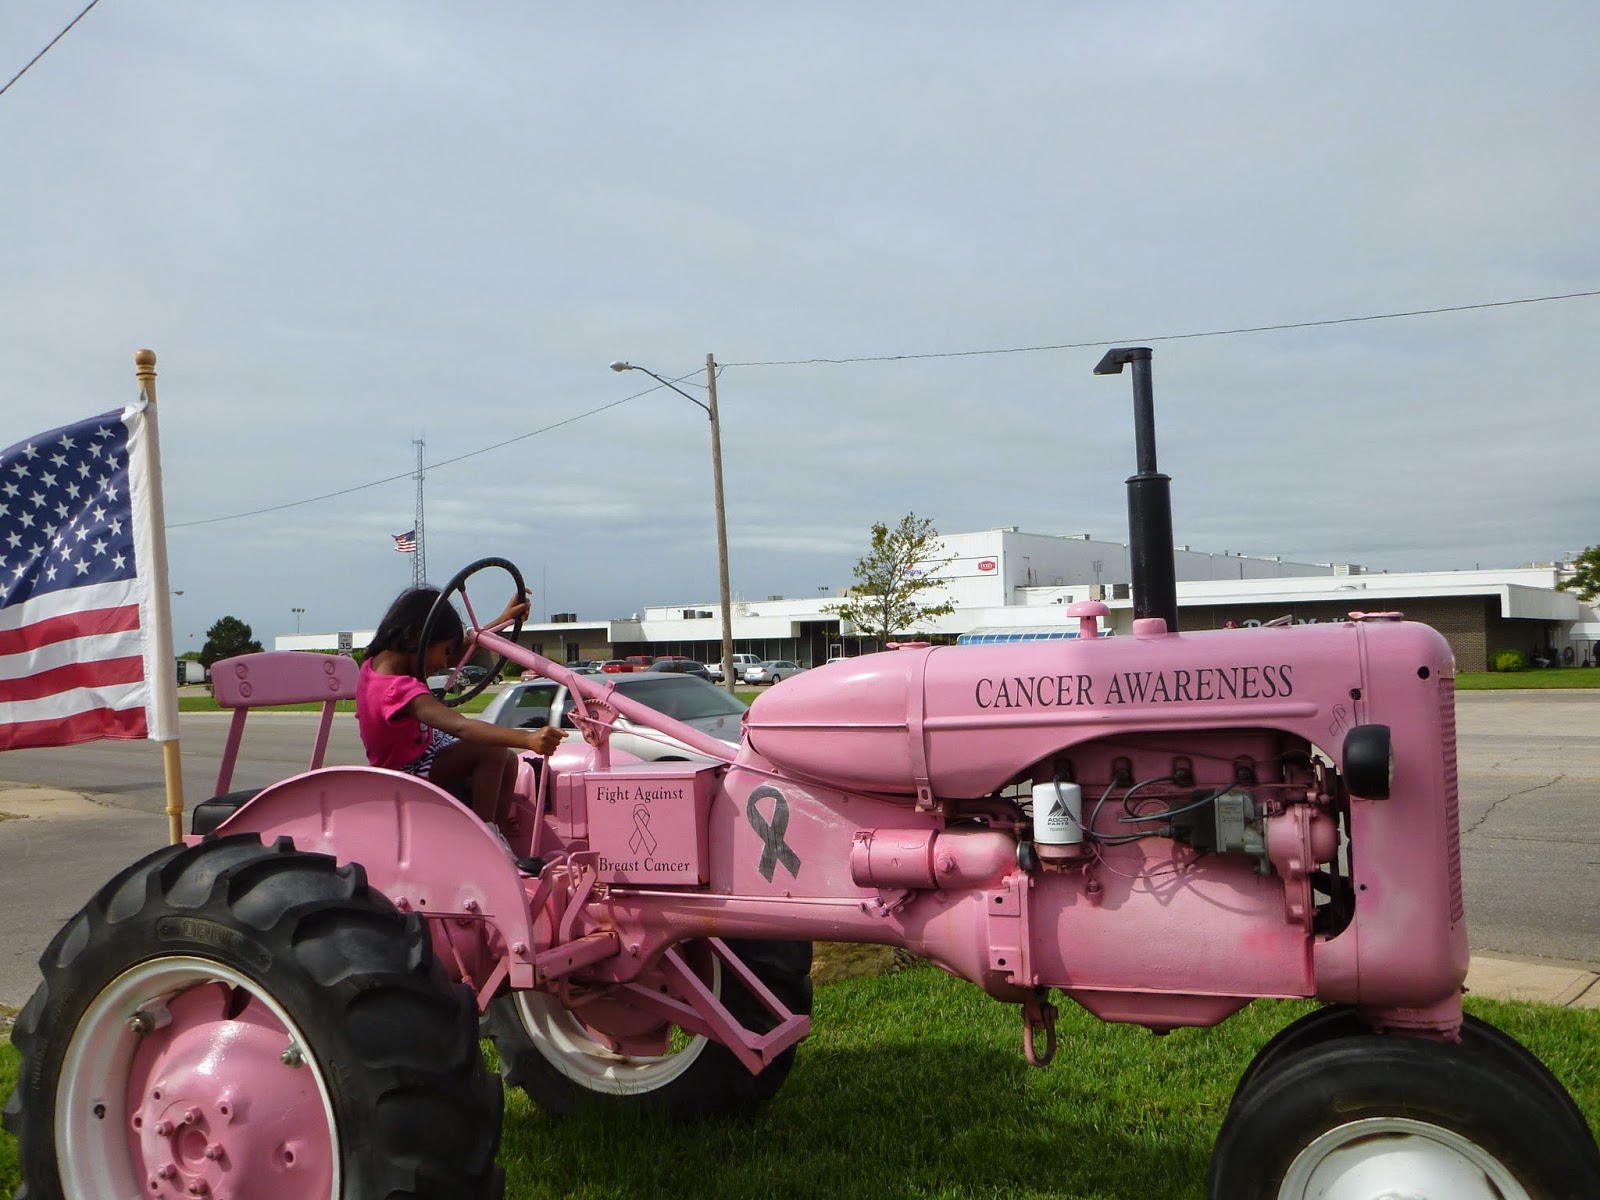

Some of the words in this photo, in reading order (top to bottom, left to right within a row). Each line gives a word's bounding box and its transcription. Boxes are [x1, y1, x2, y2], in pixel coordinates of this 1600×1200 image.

[339, 642, 352, 650] 35
[975, 673, 1095, 709] CANCER
[1104, 664, 1294, 705] AWARENESS
[597, 786, 629, 804] Fight
[634, 786, 684, 803] Against
[599, 857, 639, 872] Breast
[644, 857, 690, 872] Cancer
